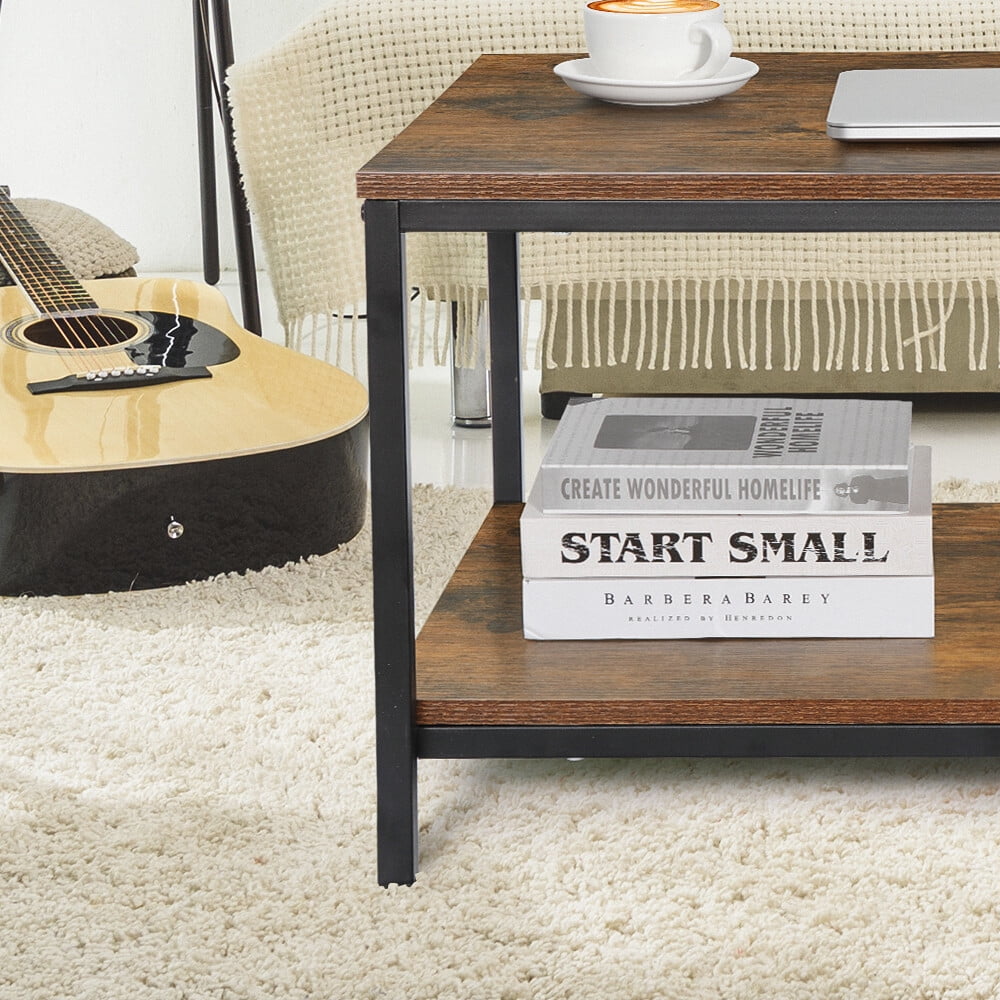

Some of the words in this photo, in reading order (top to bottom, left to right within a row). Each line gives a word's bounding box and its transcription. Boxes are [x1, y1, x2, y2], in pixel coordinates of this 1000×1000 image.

[752, 406, 792, 458] WONDERFUL
[787, 412, 824, 453] HOMELIFE
[560, 477, 621, 501] CREATE
[626, 477, 732, 501] WONDERFUL
[738, 477, 822, 501] HOMELIFE
[560, 532, 713, 564] START
[728, 531, 890, 564] SMALL
[604, 592, 731, 605] BARBERA
[744, 592, 831, 605] BAREY
[725, 614, 793, 622] HENREDON
